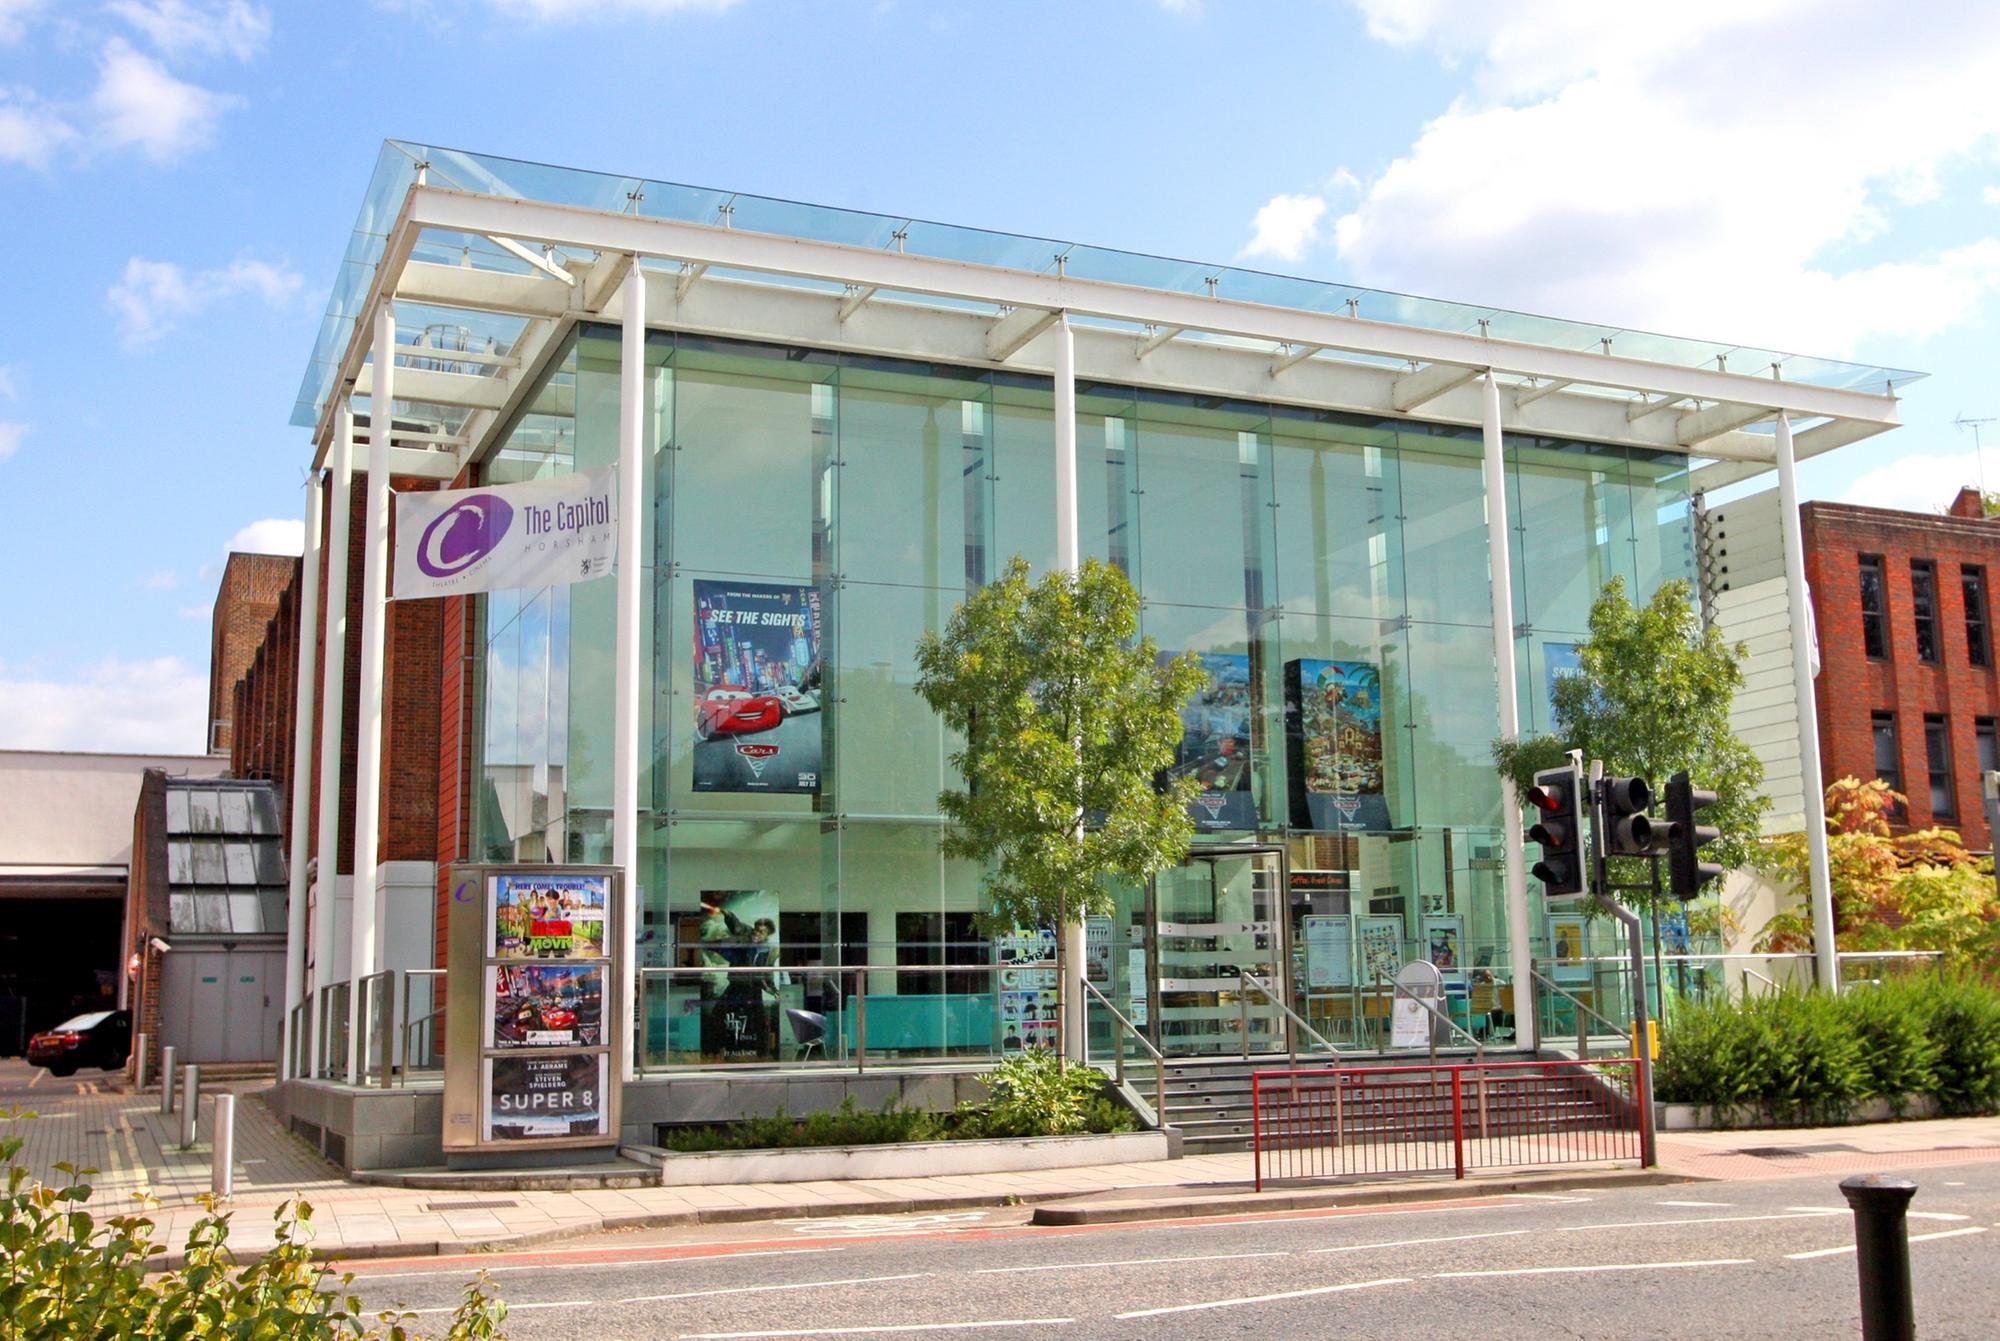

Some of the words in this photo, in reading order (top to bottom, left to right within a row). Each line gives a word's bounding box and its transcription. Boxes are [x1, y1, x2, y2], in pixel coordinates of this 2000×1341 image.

[524, 504, 551, 535] The
[557, 495, 610, 534] Capitol
[524, 533, 611, 553] HORSHAM
[709, 609, 733, 624] SEE
[736, 611, 759, 626] THE
[760, 613, 806, 628] SIGHTS
[740, 745, 774, 755] Cars
[515, 882, 531, 890] HERE
[533, 882, 554, 890] COMES
[1010, 952, 1043, 966] more
[529, 1081, 567, 1089] SPIELBERG
[500, 1092, 574, 1111] SUPER
[582, 1090, 593, 1106] 8
